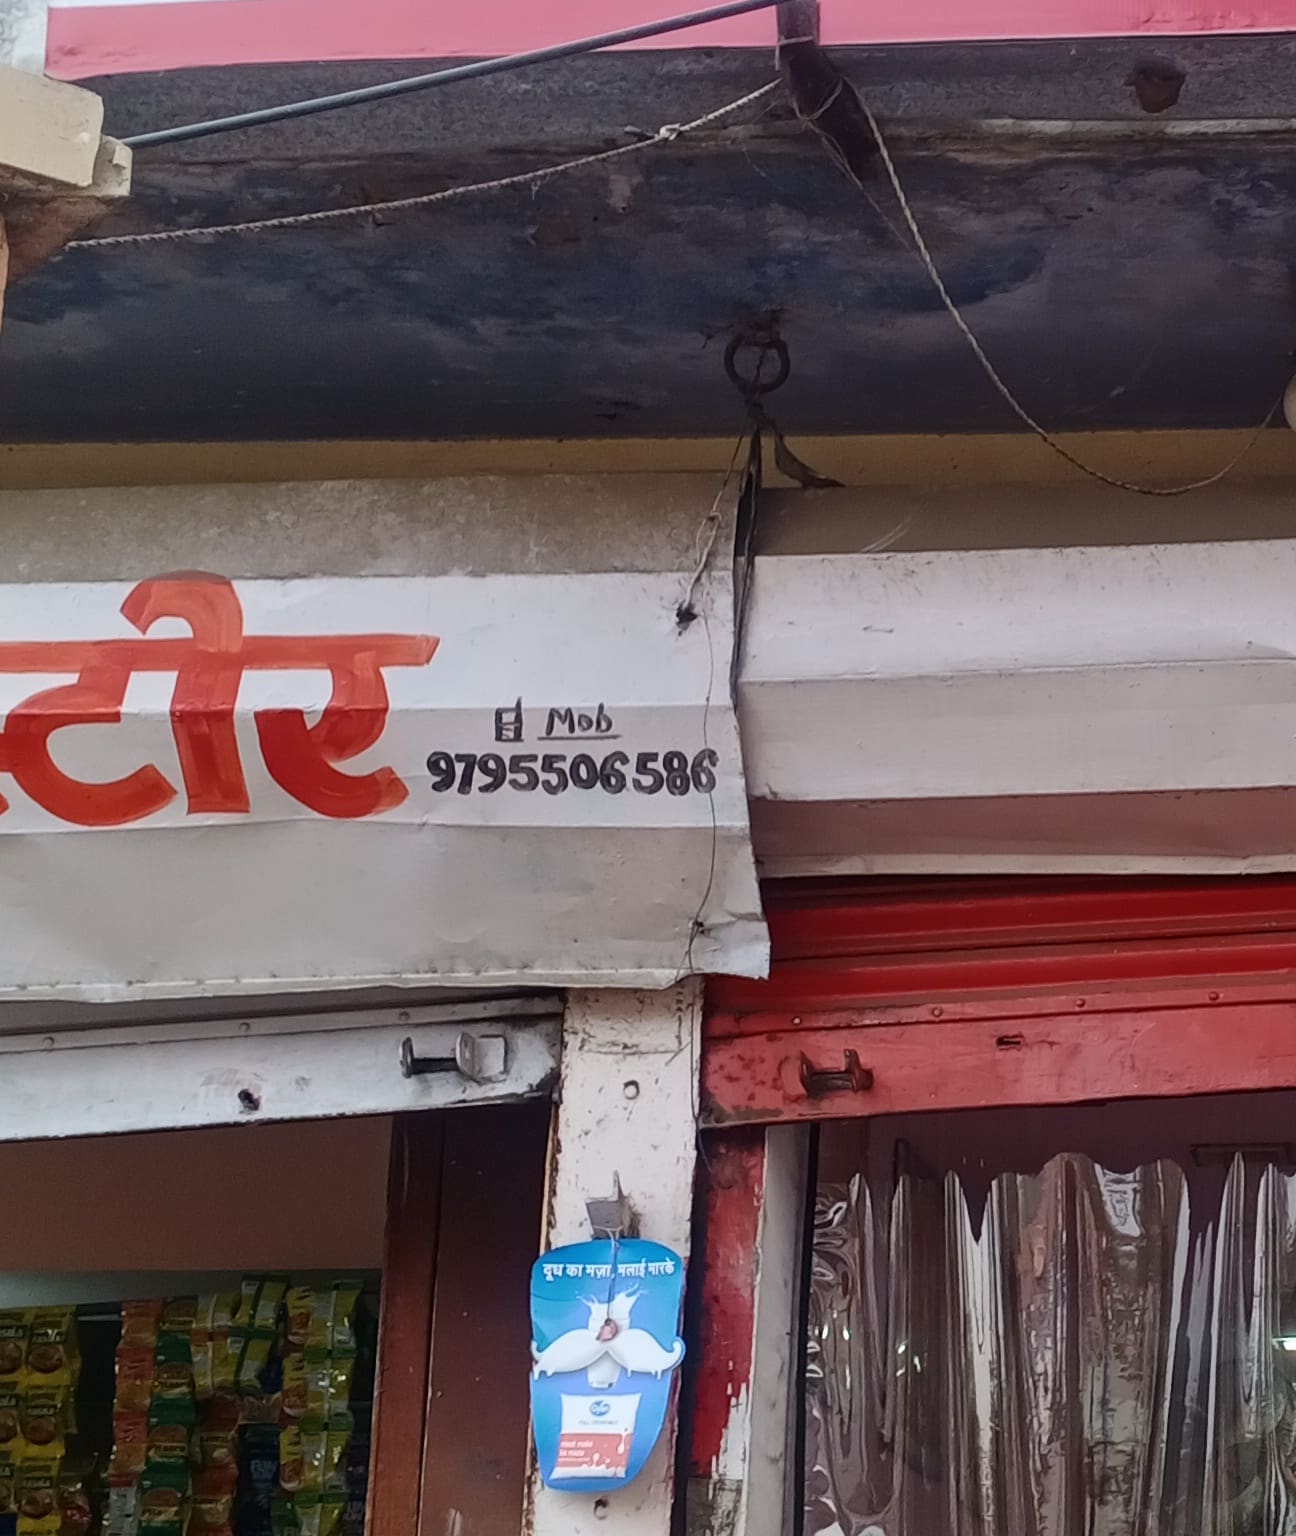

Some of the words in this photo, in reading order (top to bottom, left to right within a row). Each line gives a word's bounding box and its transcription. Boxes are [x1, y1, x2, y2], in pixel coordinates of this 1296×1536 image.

[0, 570, 440, 826] टोर
[545, 702, 613, 735] Mob
[426, 748, 719, 796] 9795506586
[566, 1263, 584, 1277] का
